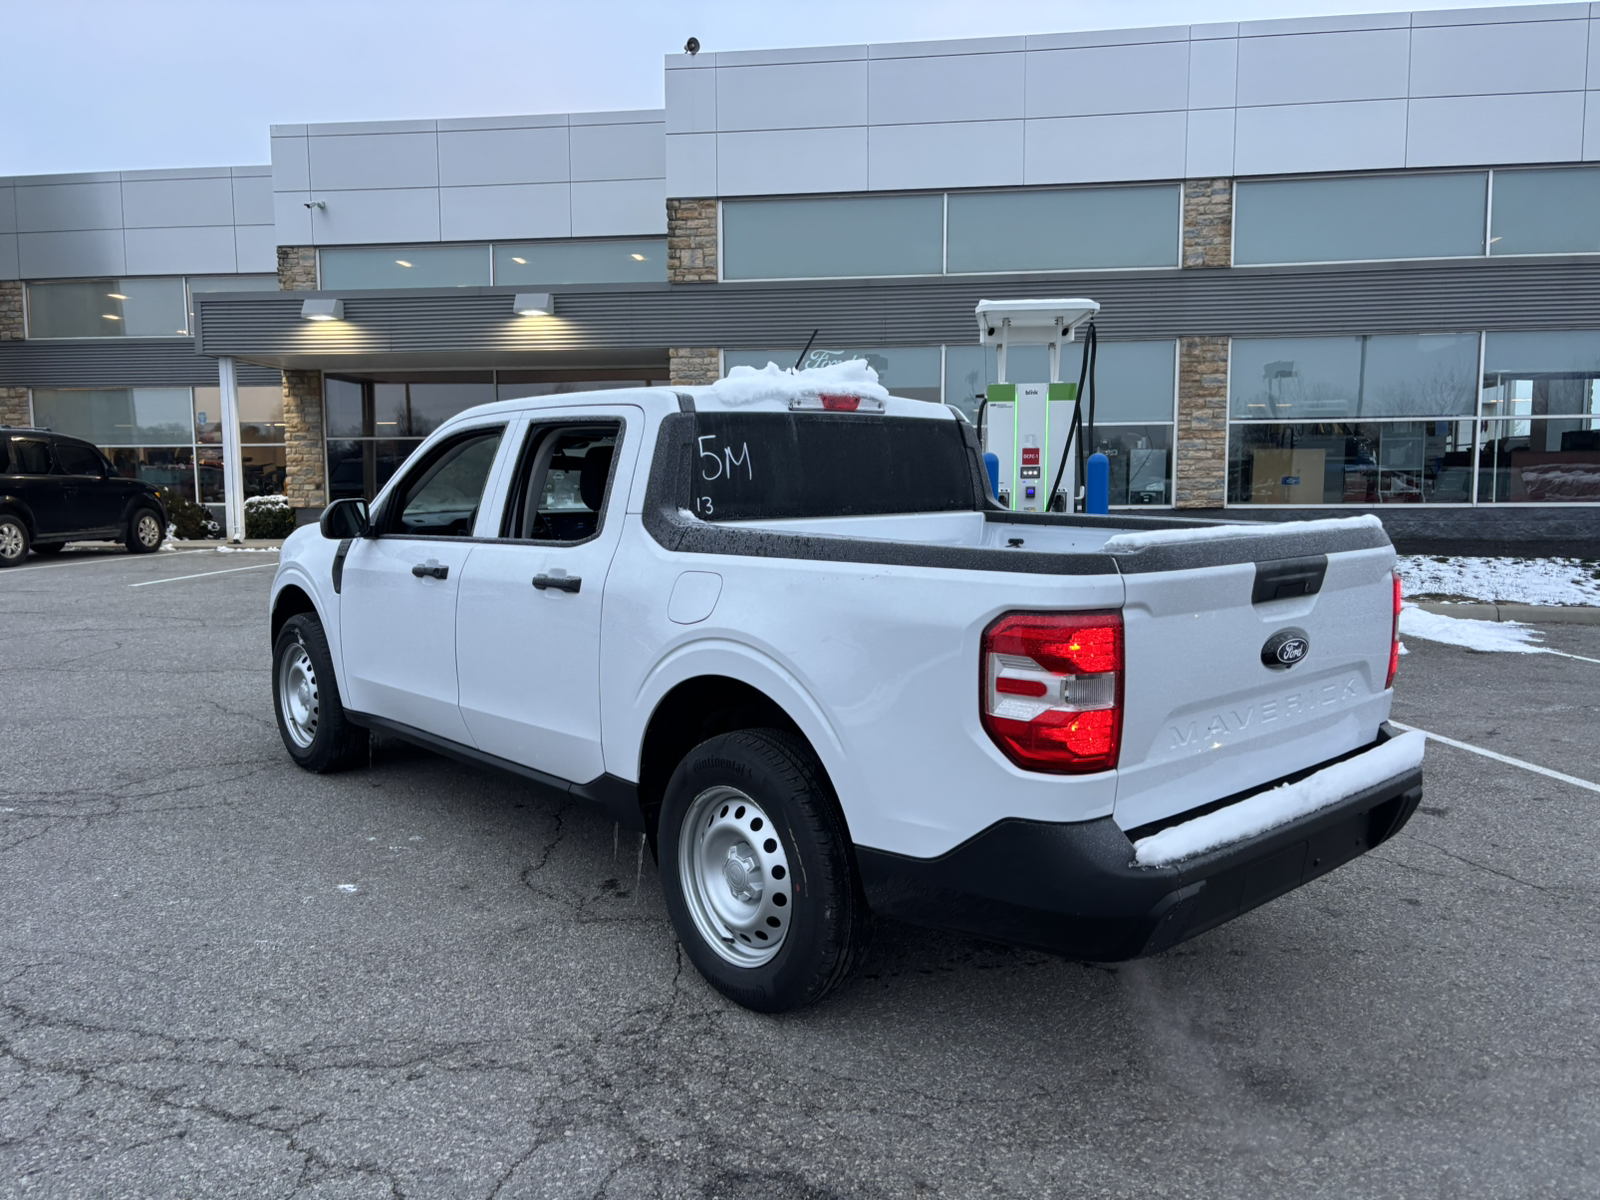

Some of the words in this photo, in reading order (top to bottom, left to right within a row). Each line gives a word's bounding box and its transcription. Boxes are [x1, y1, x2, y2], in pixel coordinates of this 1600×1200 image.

[697, 434, 753, 481] 5M
[696, 496, 714, 515] 13
[1282, 641, 1304, 660] Ford
[1169, 677, 1357, 750] MAVERICK
[693, 755, 746, 776] Continental
